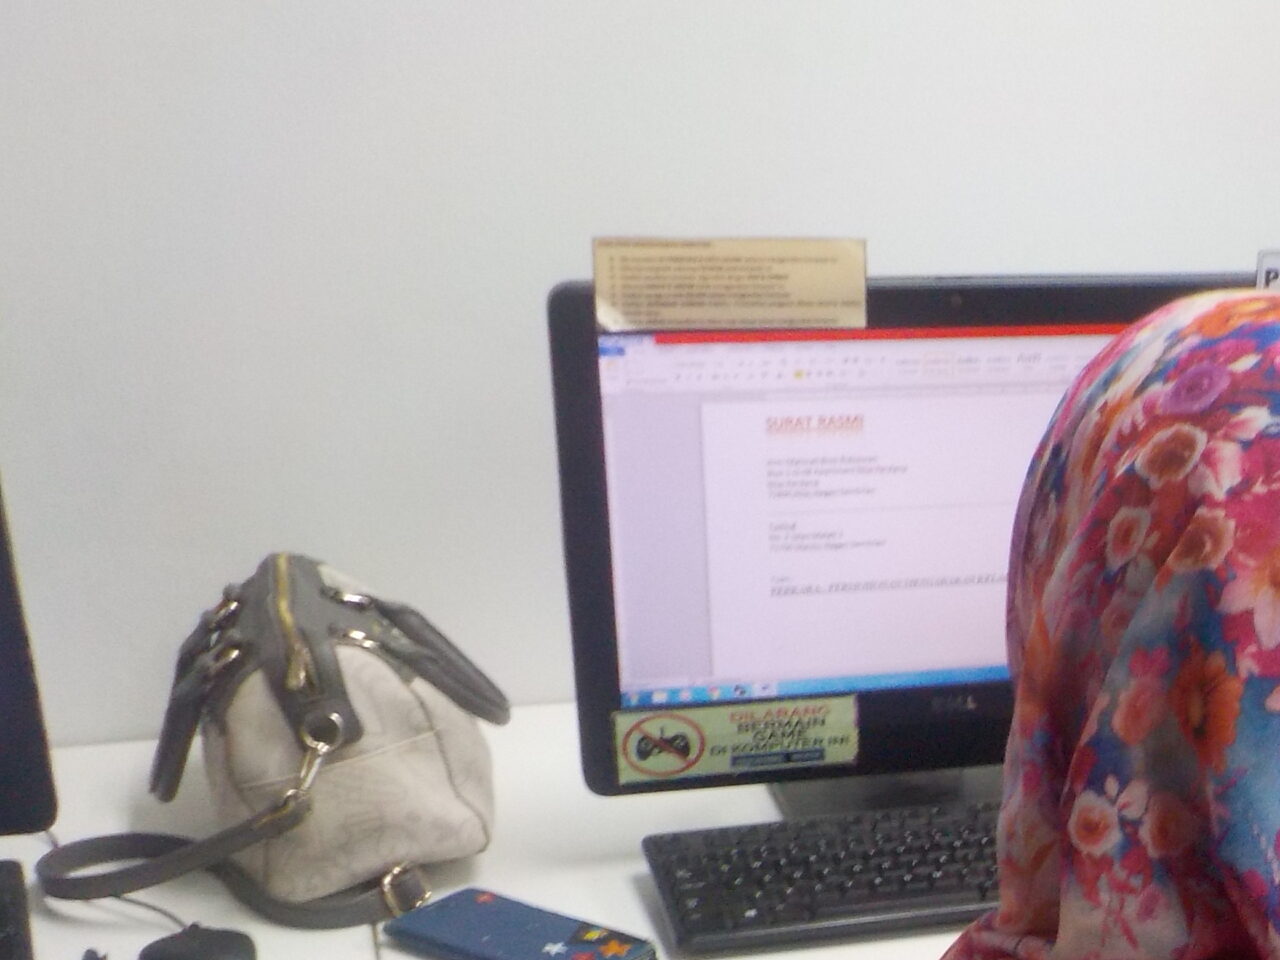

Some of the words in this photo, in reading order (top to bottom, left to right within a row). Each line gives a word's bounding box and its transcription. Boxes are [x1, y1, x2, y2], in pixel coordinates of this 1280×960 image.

[766, 416, 812, 432] SURAT
[817, 414, 864, 431] RASMI
[729, 704, 830, 722] DILARANG
[737, 716, 826, 734] BERMAIN
[731, 737, 824, 753] KOMPUTER
[752, 728, 806, 744] GAME
